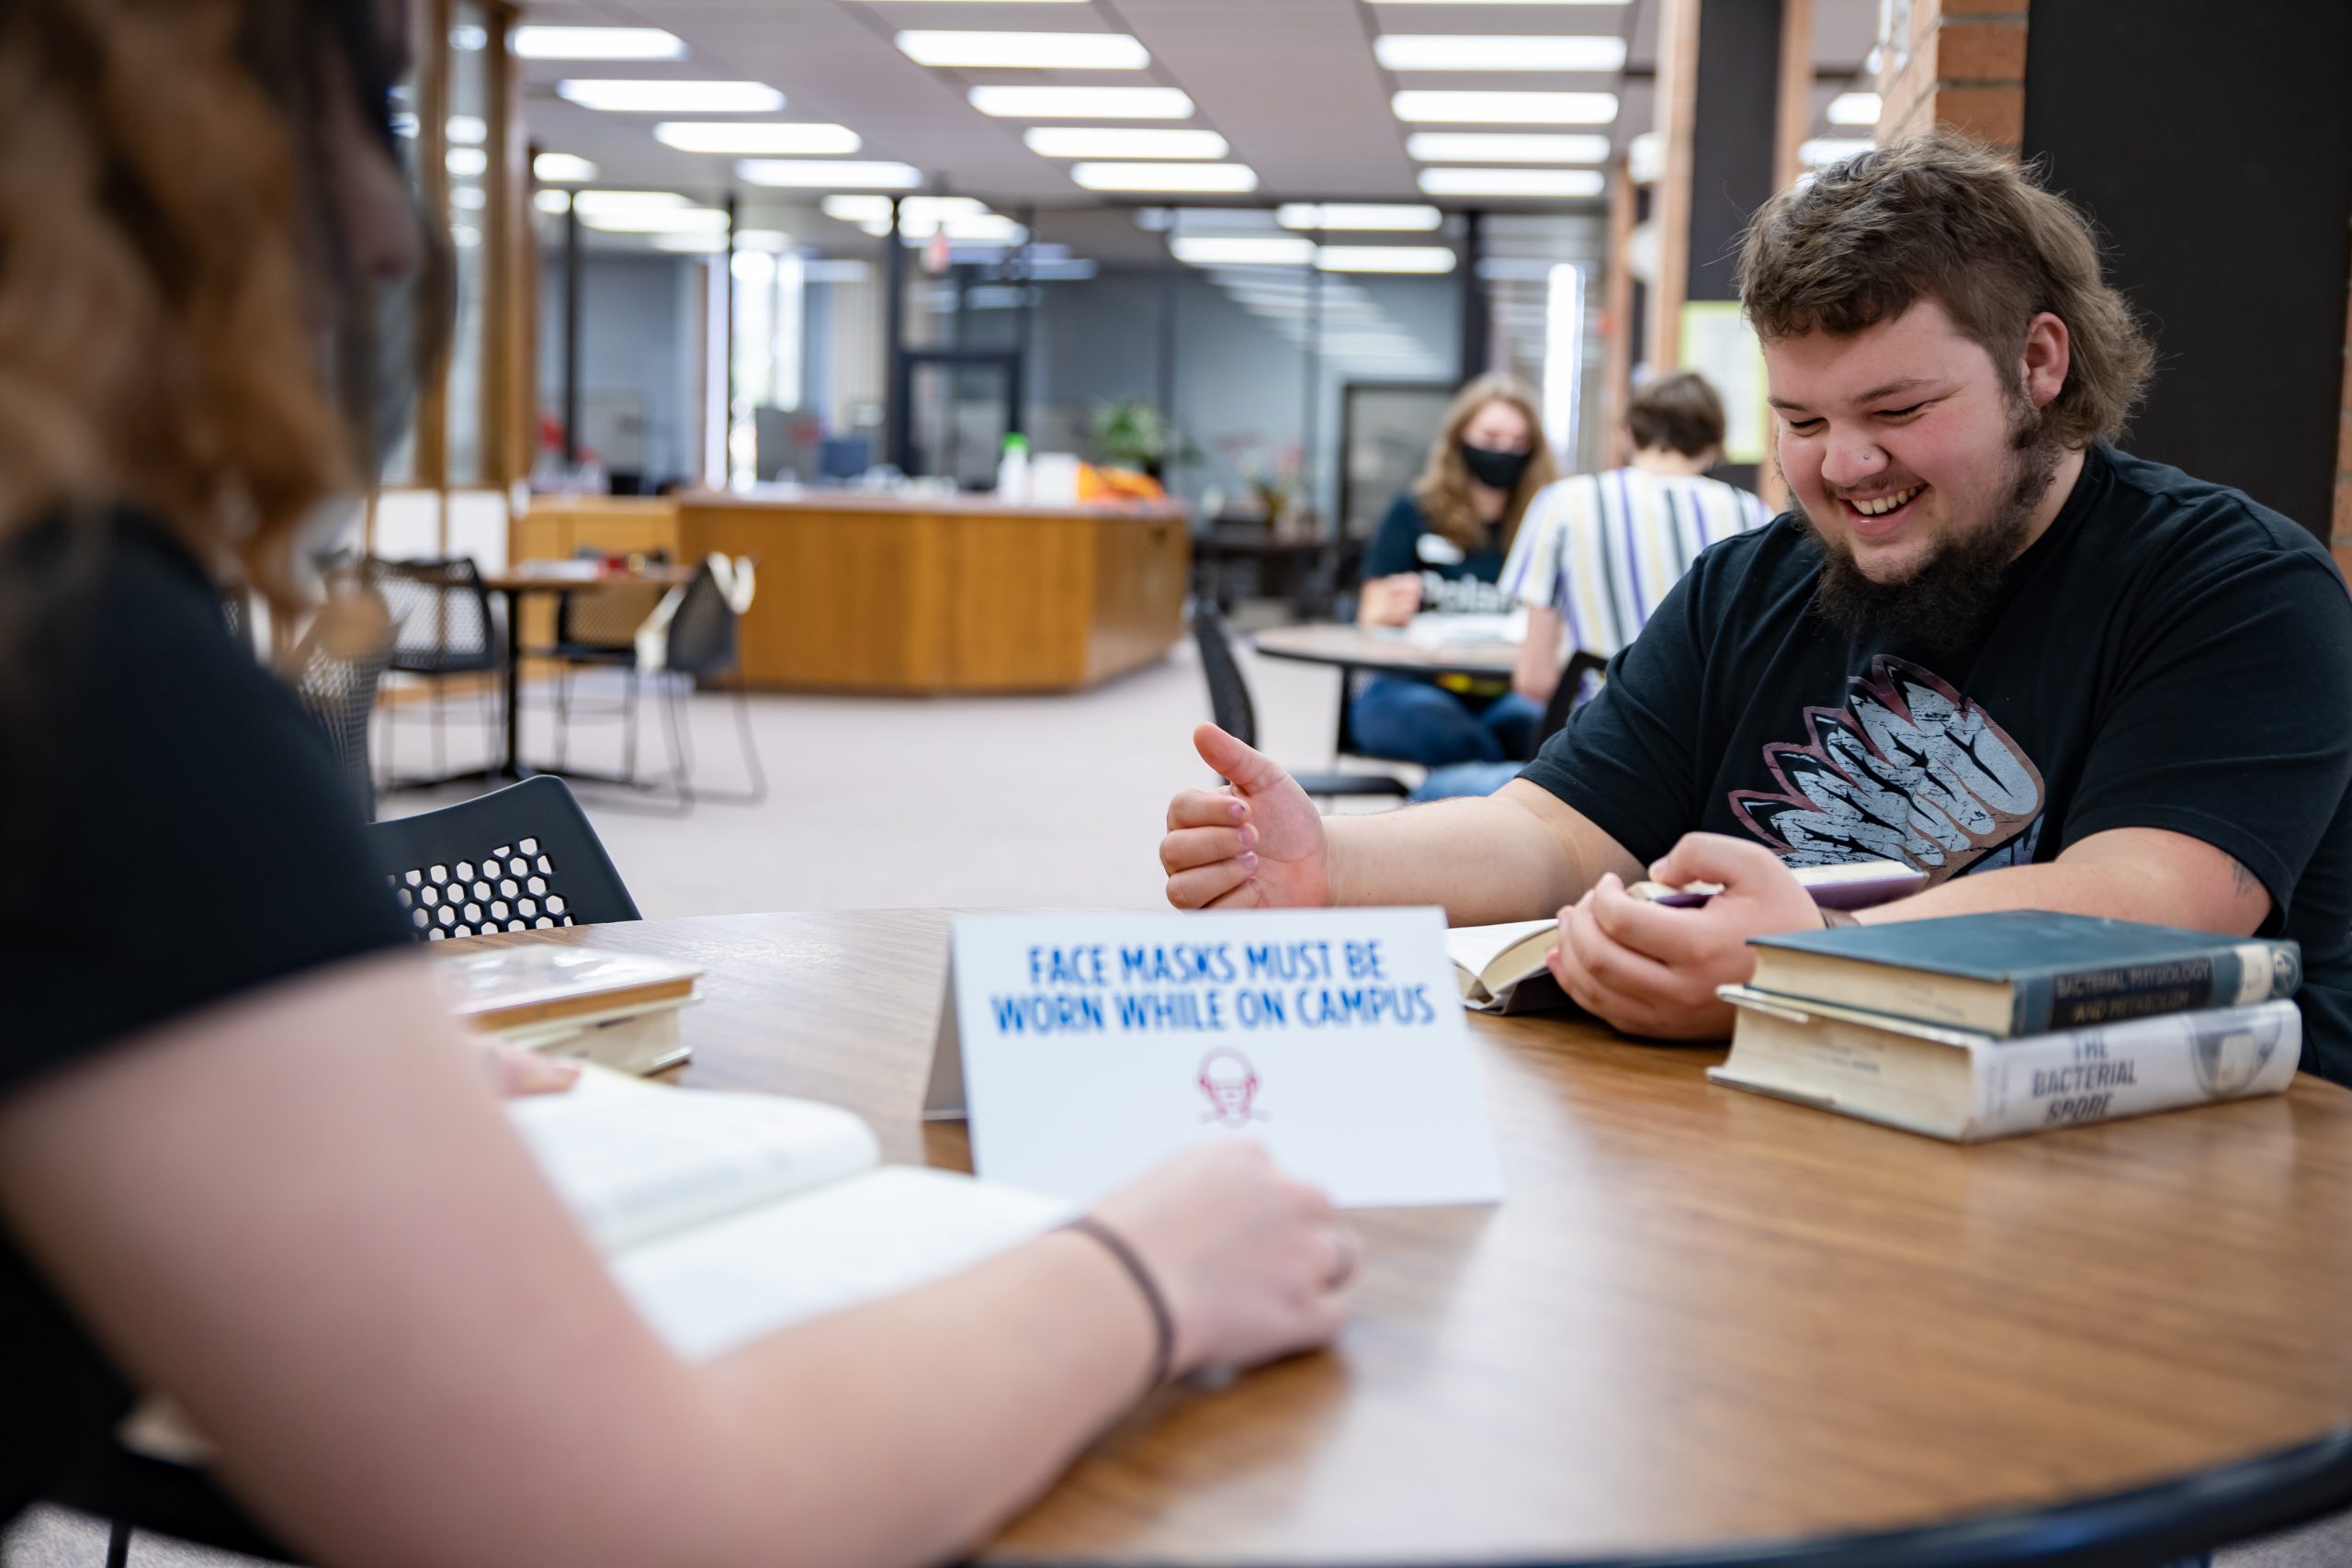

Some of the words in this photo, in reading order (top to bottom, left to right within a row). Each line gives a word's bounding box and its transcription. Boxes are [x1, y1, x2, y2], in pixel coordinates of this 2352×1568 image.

[1028, 945, 1105, 986] FACE
[1120, 942, 1237, 984] MASKS
[1246, 942, 1332, 982] MUST
[1344, 941, 1388, 979] BE
[2056, 970, 2127, 999] BACTERIAL
[2130, 958, 2209, 989] PHYSIOLOGY
[989, 993, 1104, 1035] WORN
[1114, 990, 1227, 1032] WHILE
[1236, 989, 1287, 1029] ON
[1295, 983, 1436, 1027] CAMPUS
[2073, 998, 2107, 1023] AND
[2070, 1030, 2109, 1060] THE
[2030, 1059, 2137, 1099] BACTERIAL
[2044, 1090, 2114, 1123] SPORE
